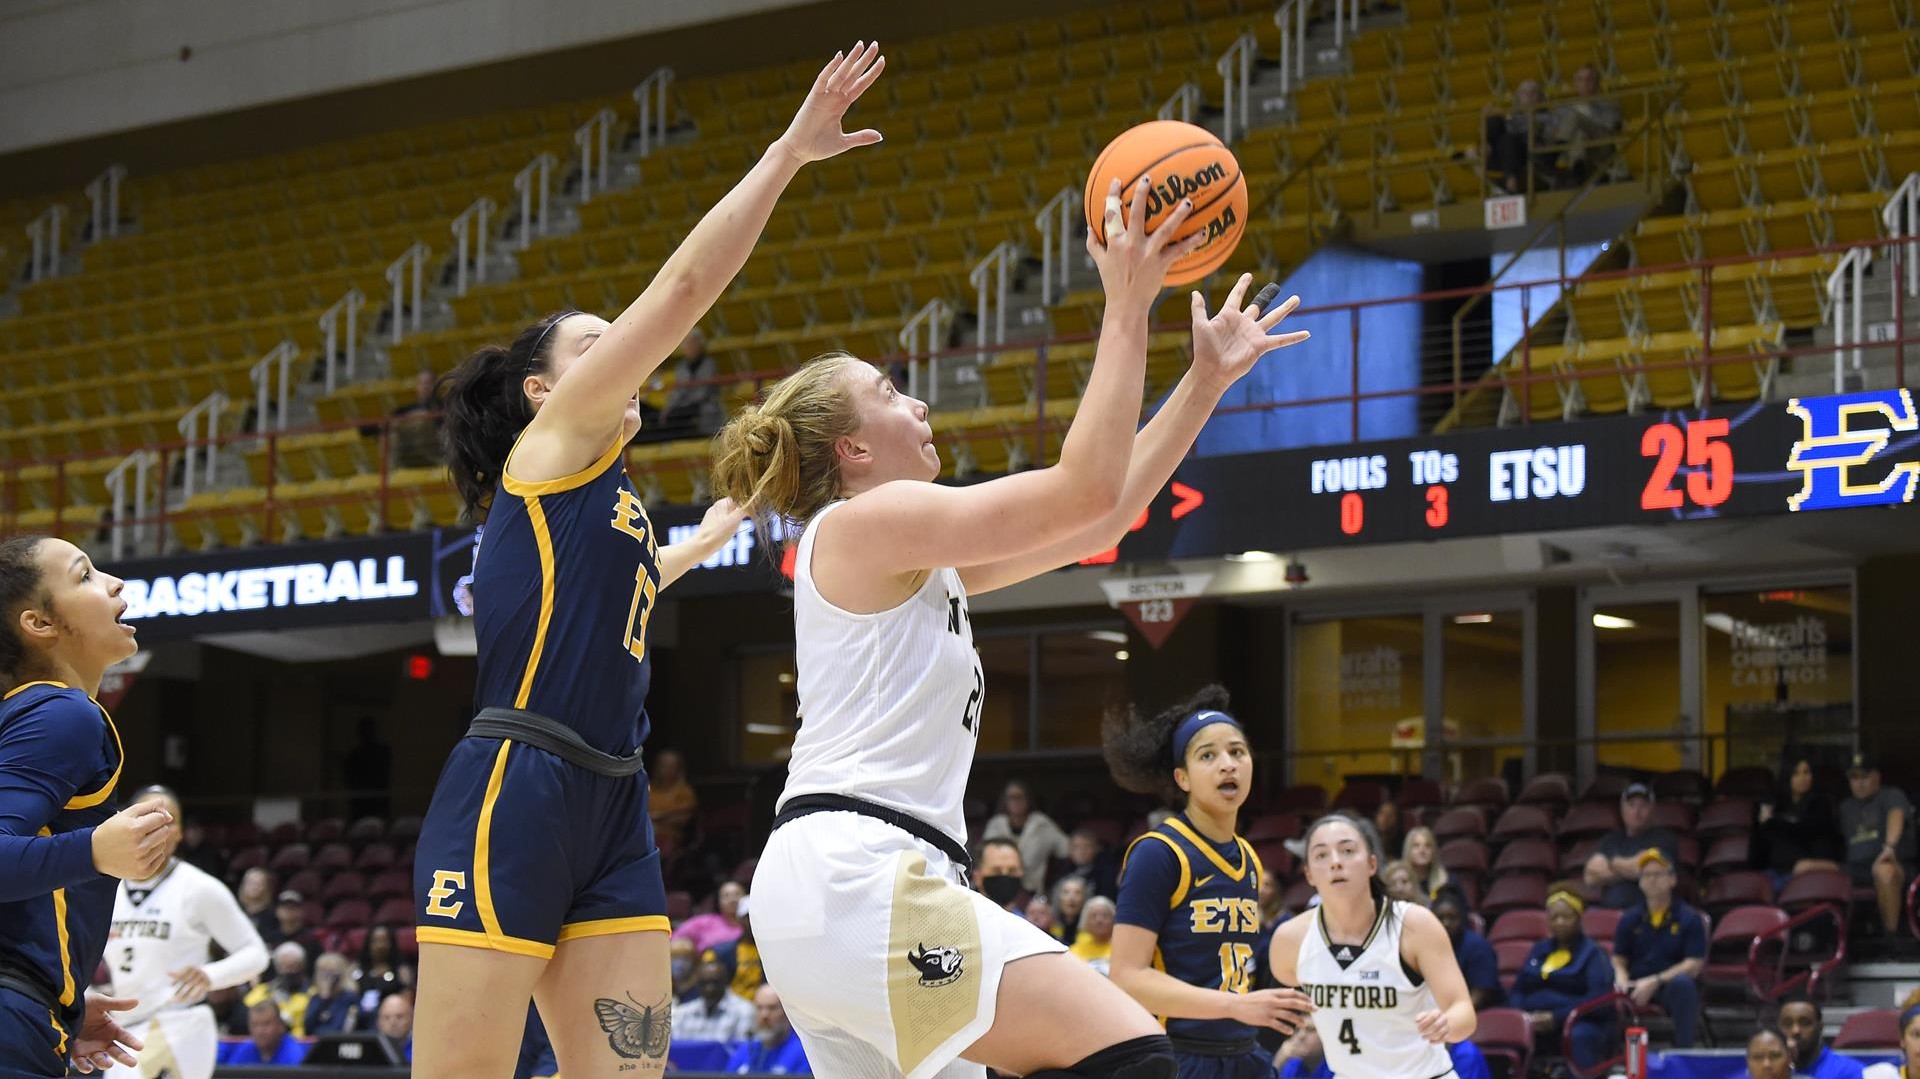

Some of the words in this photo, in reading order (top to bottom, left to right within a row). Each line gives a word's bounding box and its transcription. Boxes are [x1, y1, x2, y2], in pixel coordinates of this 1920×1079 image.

[1491, 201, 1519, 225] EXIT
[1311, 454, 1387, 494] FOULS
[1408, 449, 1459, 485] TOs
[1489, 444, 1586, 502] ETSU
[1641, 418, 1734, 510] 25
[1340, 492, 1364, 535] 0
[1425, 484, 1448, 528] 3
[120, 555, 418, 620] BASKETBALL
[623, 562, 657, 663] 13
[1128, 581, 1186, 595] SECTION
[1140, 598, 1174, 622] 123
[426, 869, 466, 919] E
[1189, 897, 1259, 934] ETS
[1218, 942, 1253, 994] 10
[1338, 1018, 1362, 1055] 4
